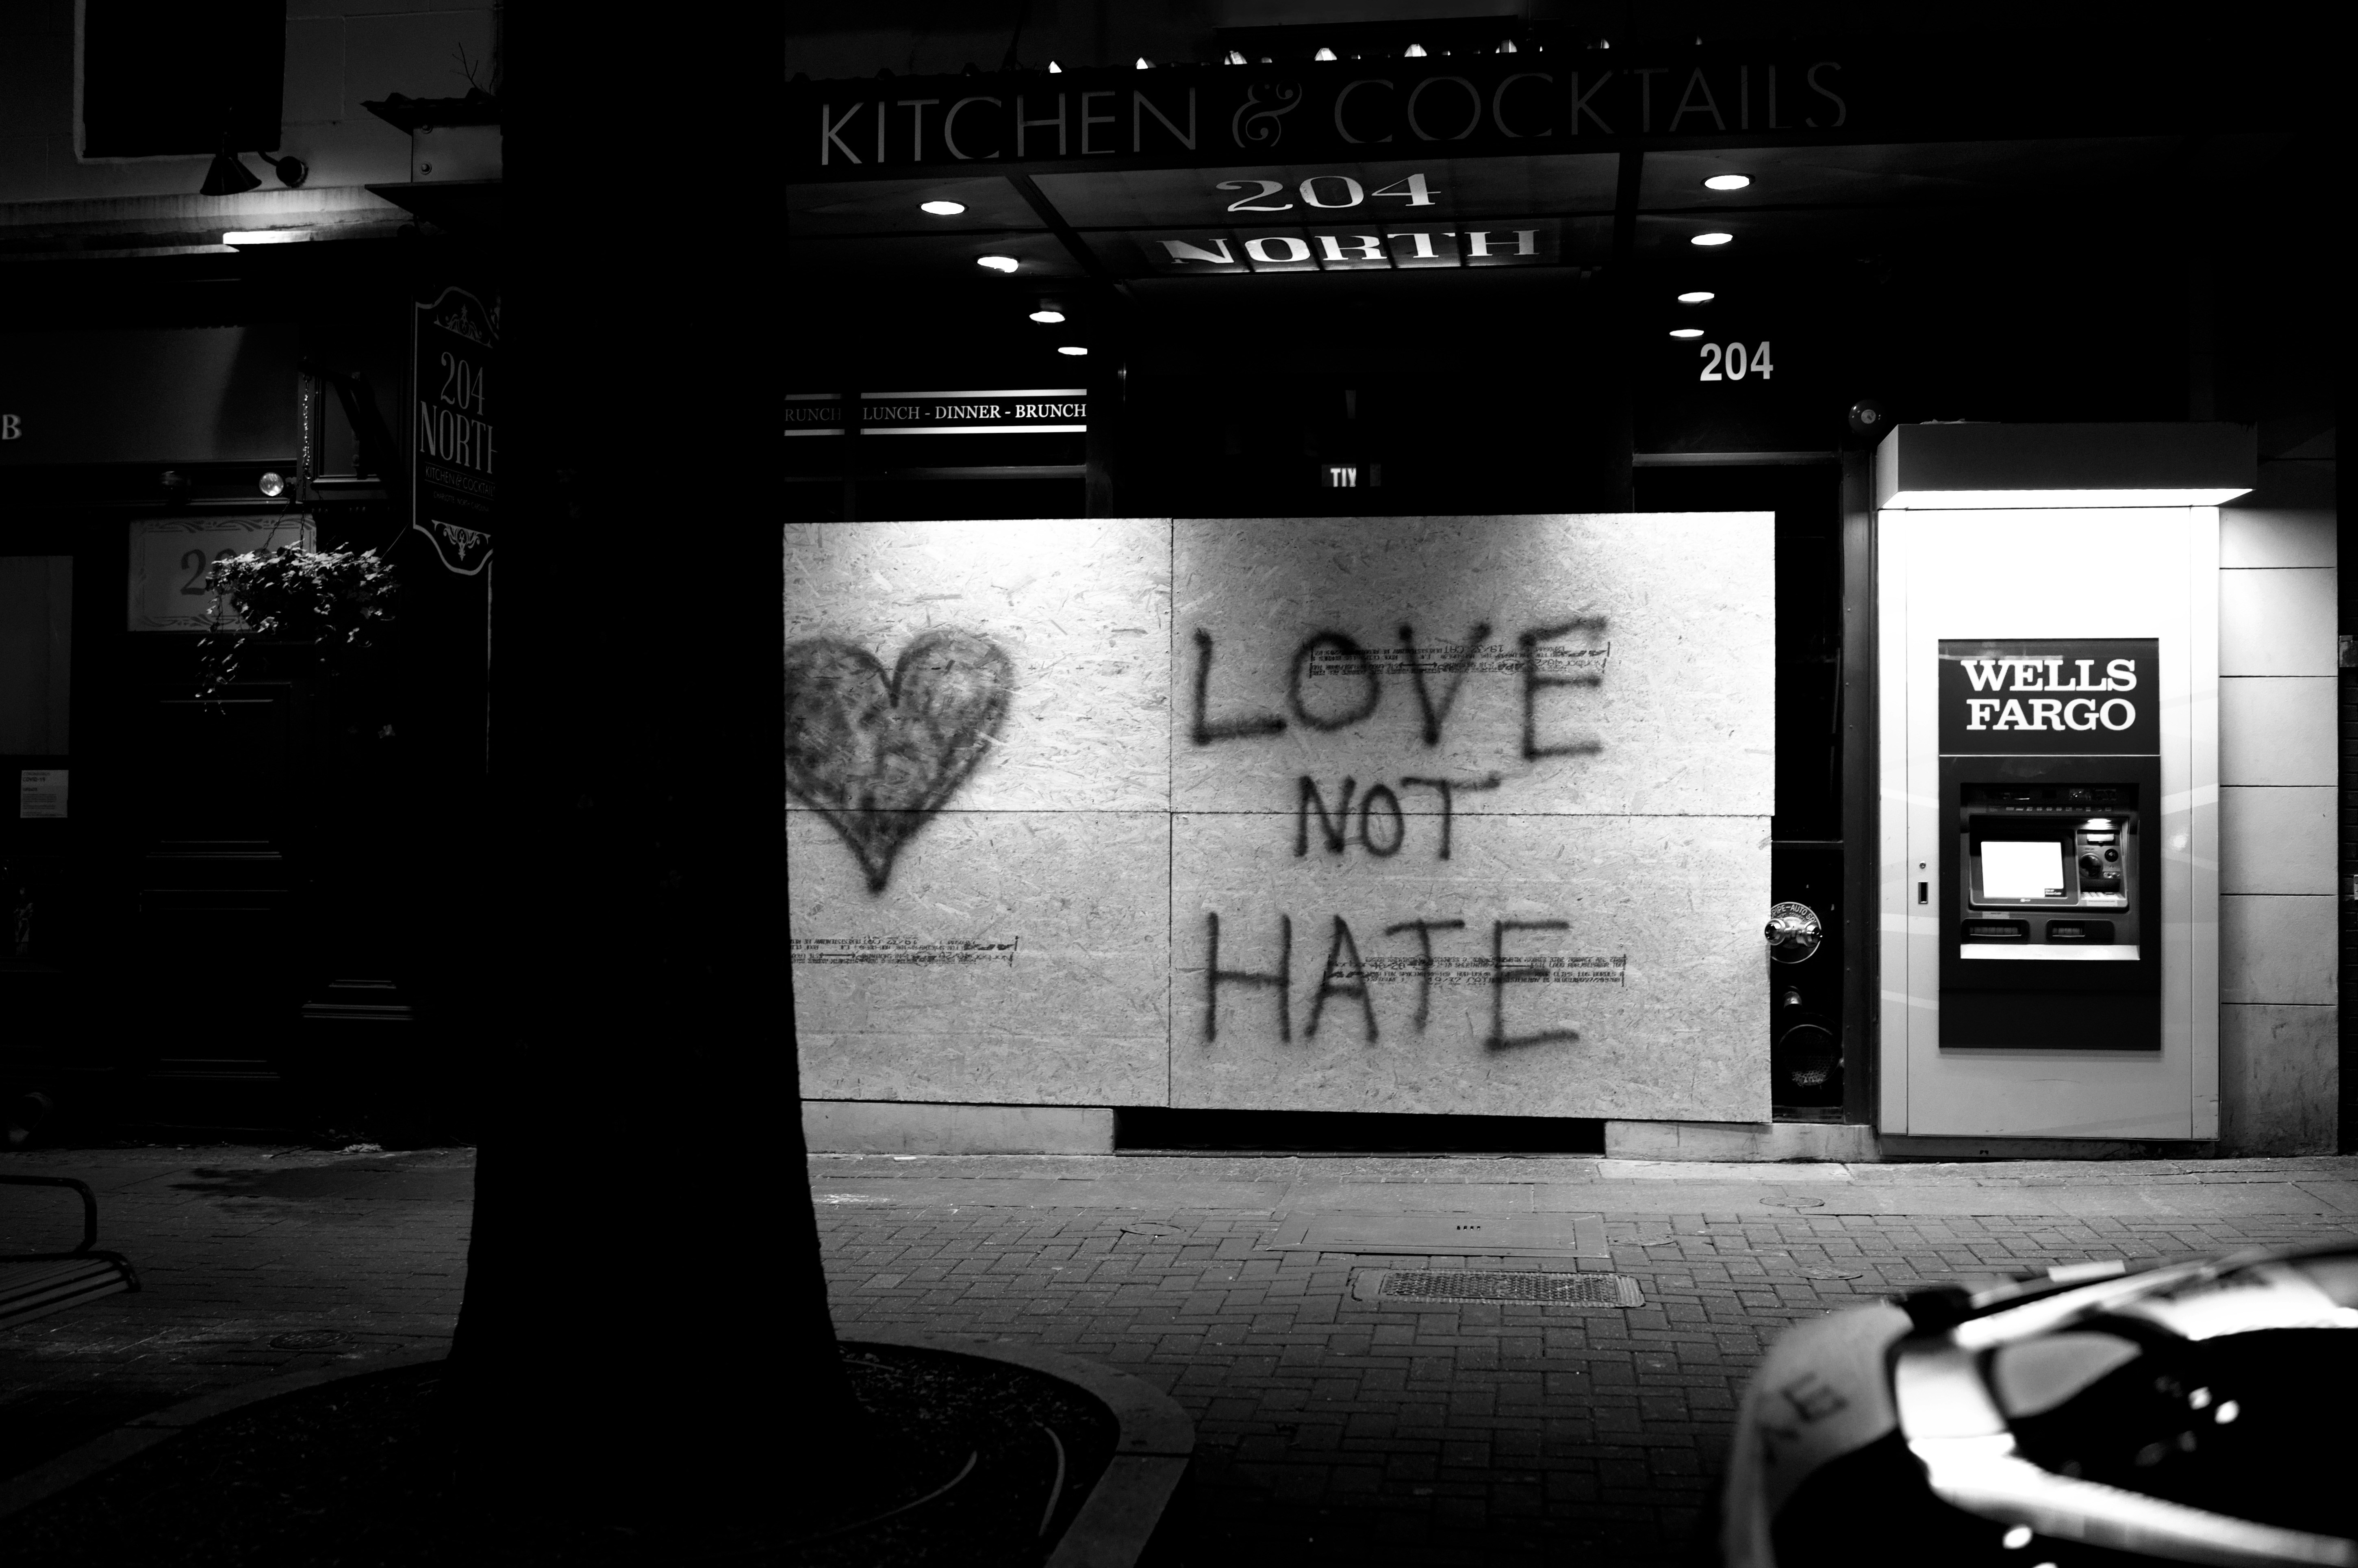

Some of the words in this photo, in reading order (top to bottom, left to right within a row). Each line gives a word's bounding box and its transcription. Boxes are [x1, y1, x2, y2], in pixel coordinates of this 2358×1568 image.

[821, 86, 1196, 165] KITCHEN
[1232, 79, 1302, 148] &
[1333, 61, 1848, 144] COCKTAILS
[1216, 173, 1442, 212] 204
[1156, 229, 1540, 264] NORTH
[1700, 340, 1774, 382] 204
[441, 351, 485, 416] 204
[784, 408, 841, 421] RUNCH
[862, 406, 920, 421] LUNCH
[934, 405, 1002, 419] DINNER
[1014, 403, 1087, 419] BRUNCH
[419, 400, 498, 475] NORTH
[426, 465, 454, 485] KITCHEN
[1191, 616, 1608, 761] LOVE
[1960, 659, 2137, 692] WELLS
[1966, 698, 2137, 731] FARGO
[1294, 774, 1503, 860] NOT
[1204, 911, 1580, 1052] HATE
